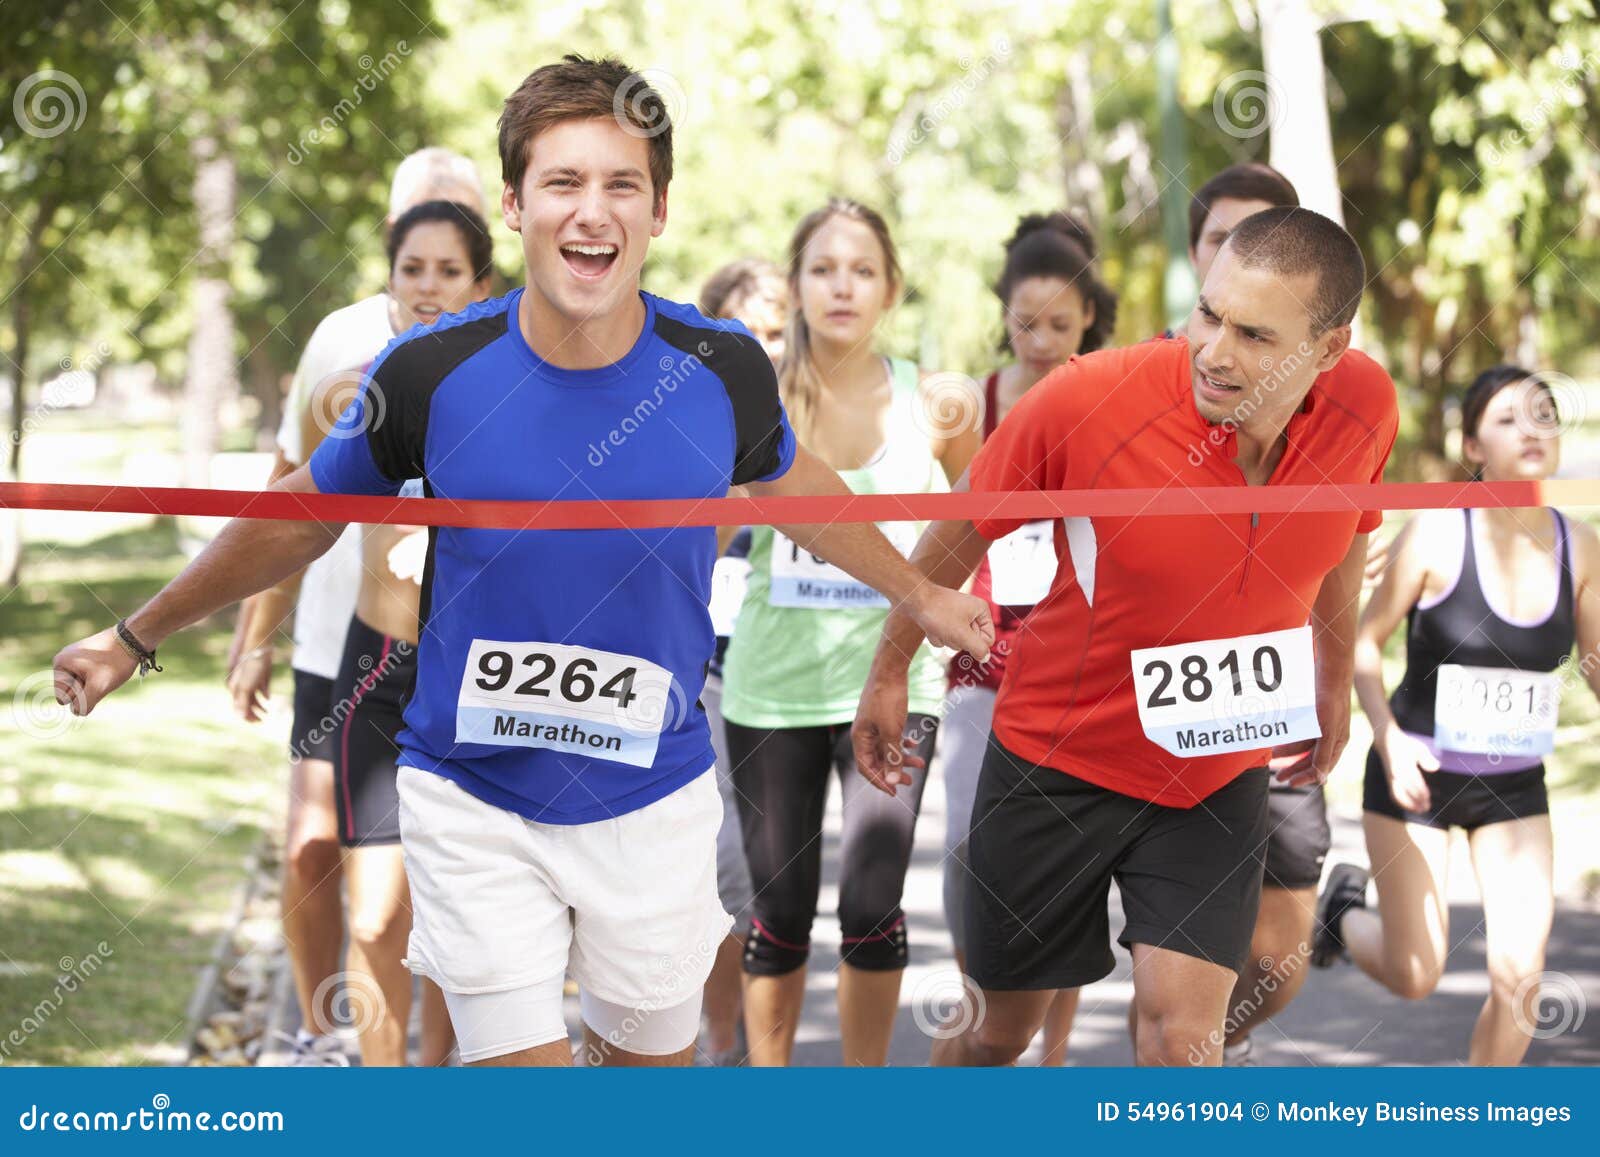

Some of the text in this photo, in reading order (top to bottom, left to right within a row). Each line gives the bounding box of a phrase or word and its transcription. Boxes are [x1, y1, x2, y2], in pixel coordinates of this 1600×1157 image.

[475, 650, 637, 709] 9264
[1143, 645, 1282, 708] 2810
[493, 715, 622, 751] Marathon
[1176, 721, 1288, 750] Marathon
